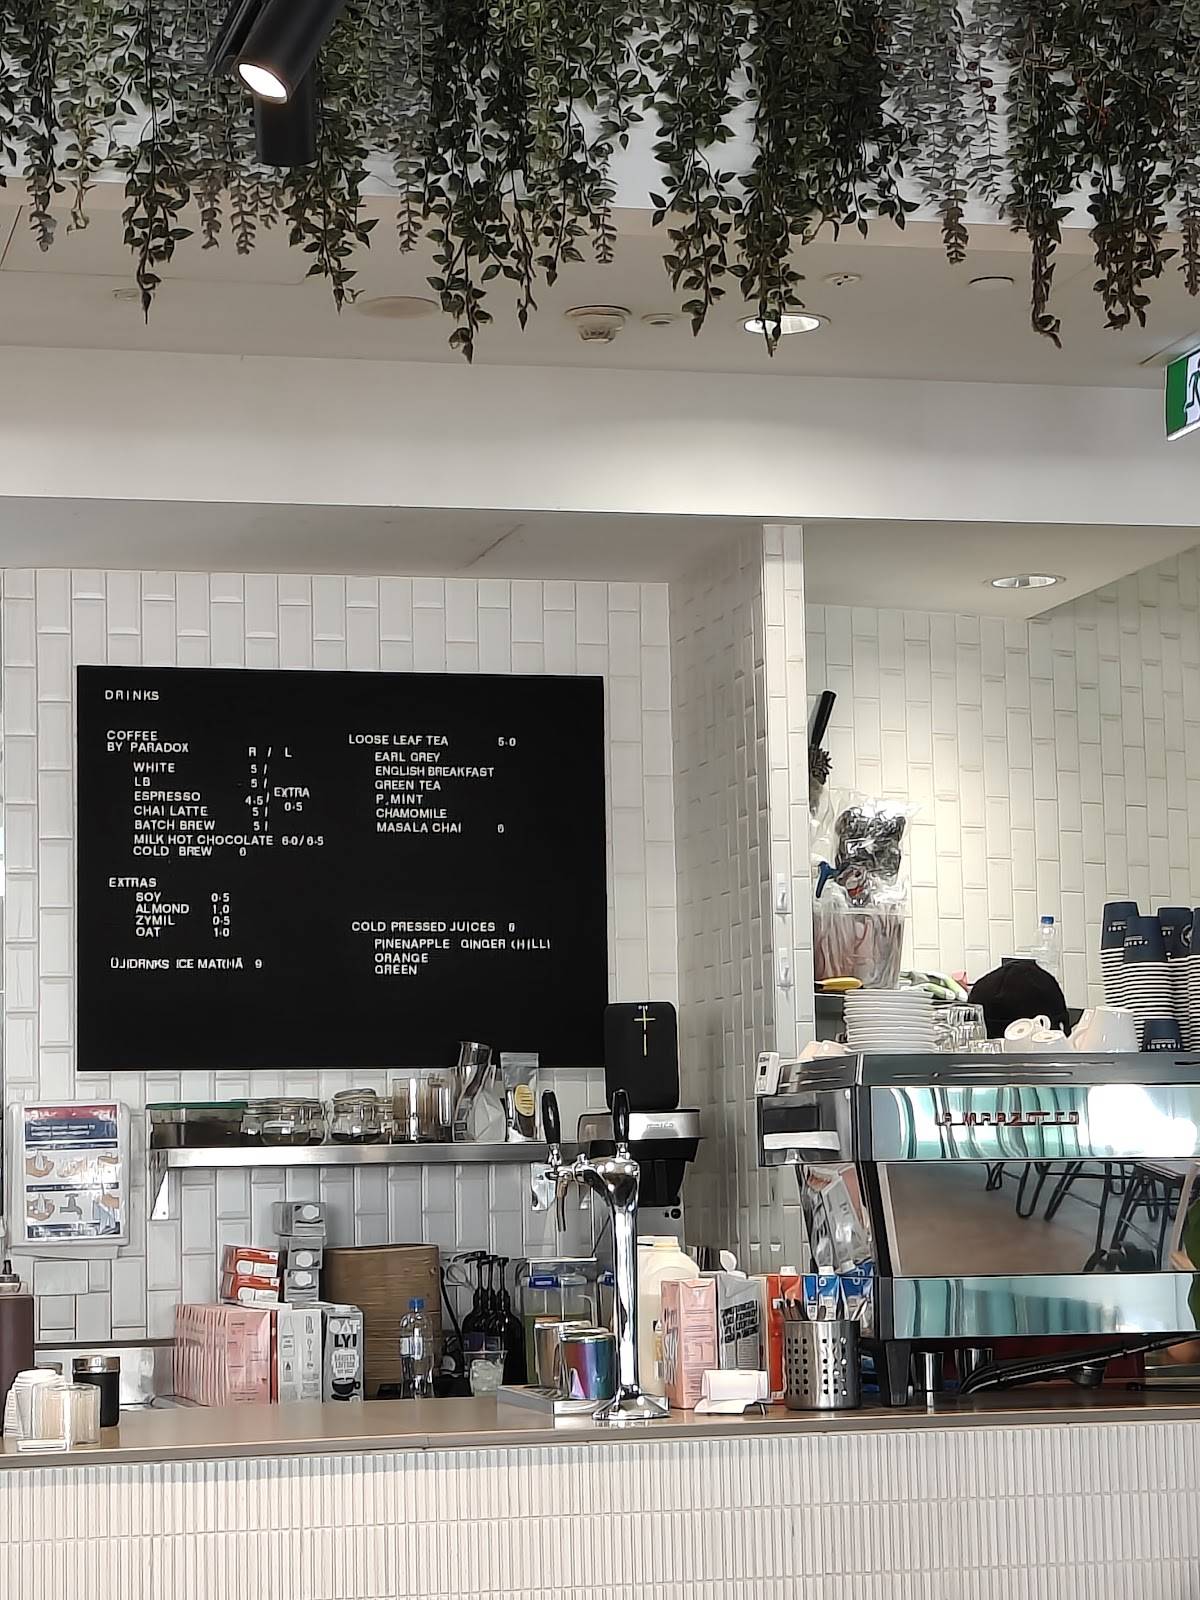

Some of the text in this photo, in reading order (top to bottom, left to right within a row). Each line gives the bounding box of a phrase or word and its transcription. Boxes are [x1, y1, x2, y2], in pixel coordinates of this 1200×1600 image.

[105, 690, 159, 700] DRINKS
[107, 730, 158, 741] COFFEE
[349, 734, 389, 744] LOOSE
[394, 735, 422, 745] LEAF
[426, 736, 448, 746] TEA
[107, 742, 188, 752] BY PARADOX
[249, 747, 256, 756] R
[285, 747, 292, 757] L
[375, 752, 440, 762] EARL GREY
[134, 762, 175, 772] WHITE
[376, 766, 494, 777] ENGLISH BREAKFAST
[375, 780, 441, 791] GREEN TEA
[135, 791, 200, 801] ESPRESSO
[274, 787, 309, 798] EXTRA
[134, 805, 164, 816] CHAI
[170, 806, 208, 816] LATTE
[376, 808, 447, 818] CHAMOMILE
[135, 820, 174, 830] BATCH
[180, 820, 215, 830] BREW
[377, 822, 428, 832] MASALA
[432, 822, 461, 832] CHAI
[134, 834, 164, 845] MILK
[168, 835, 192, 845] HOT
[197, 835, 273, 845] CHOCOLATE
[133, 845, 169, 856] COLD
[179, 846, 212, 856] BREW
[109, 878, 156, 888] EXTRAS
[136, 892, 161, 902] SOY
[136, 903, 189, 914] ALMOND
[136, 915, 175, 926] ZYMIL
[352, 921, 386, 931] COLD
[391, 922, 446, 932] PRESSED
[450, 922, 495, 932] JUICES
[136, 927, 161, 937] OAT
[375, 938, 449, 950] PINENAPPLE
[461, 939, 505, 949] GINGER
[375, 953, 428, 963] ORANGE
[176, 959, 194, 968] ICE
[255, 959, 262, 968] 9
[375, 964, 417, 975] GREEN
